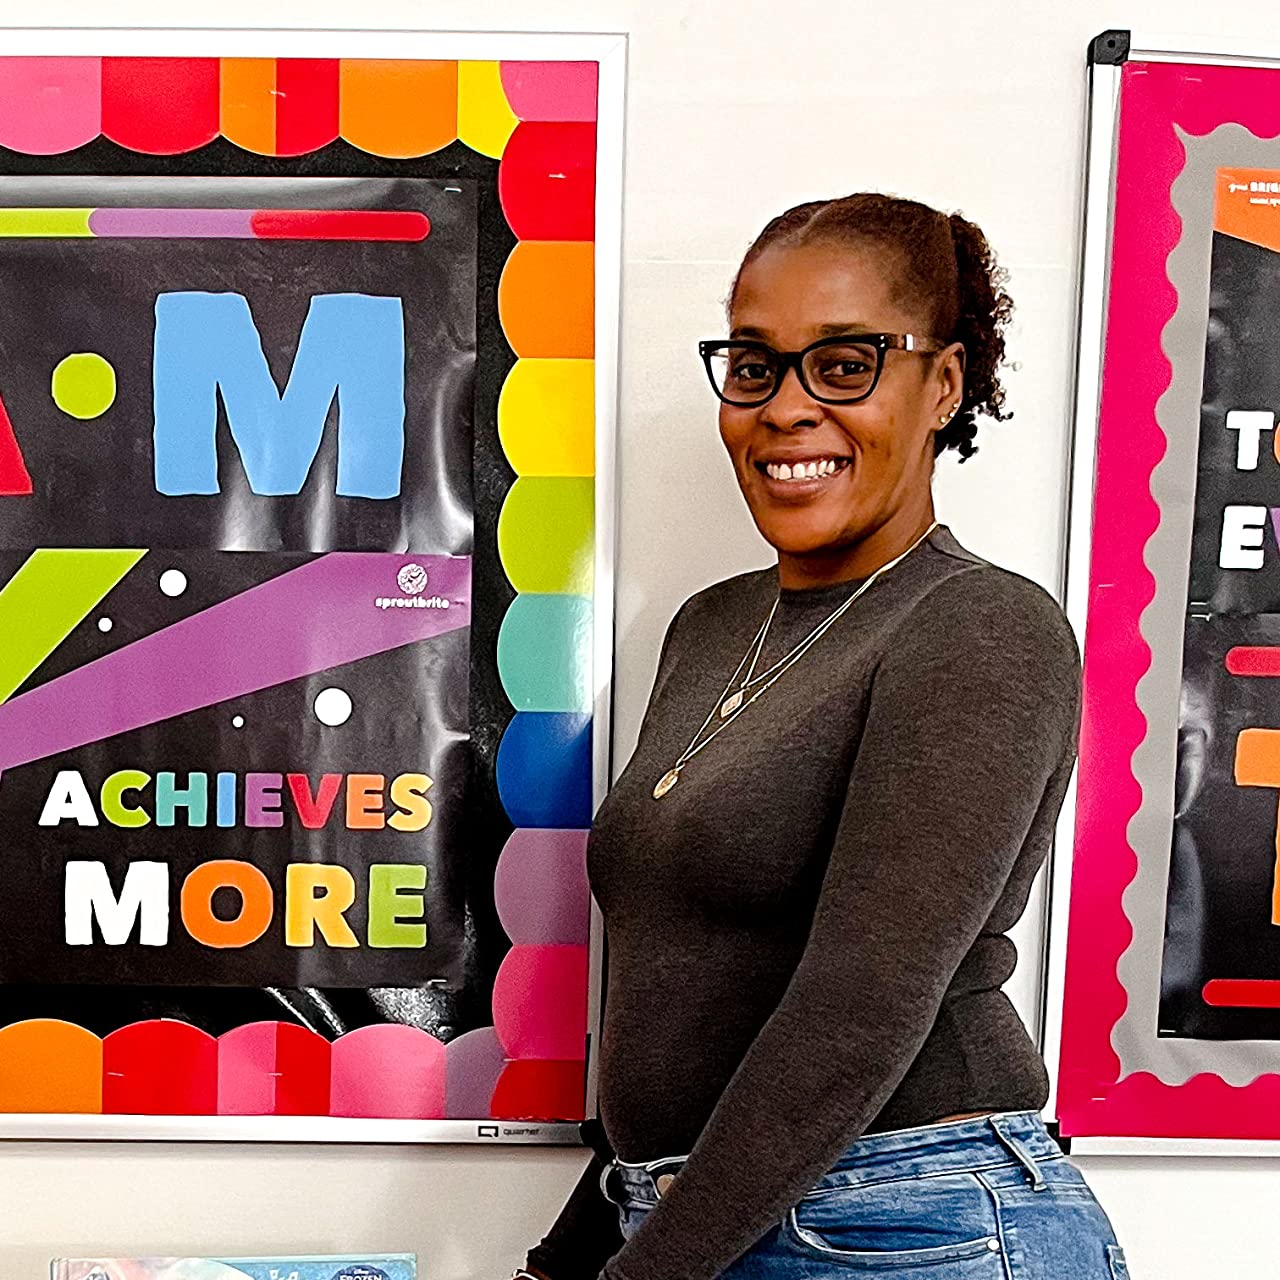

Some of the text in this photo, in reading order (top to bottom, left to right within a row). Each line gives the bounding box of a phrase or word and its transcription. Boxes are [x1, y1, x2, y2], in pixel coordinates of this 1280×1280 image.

[375, 596, 450, 609] sproutbrite
[38, 770, 433, 832] ACHIEVES
[64, 859, 428, 949] MORE
